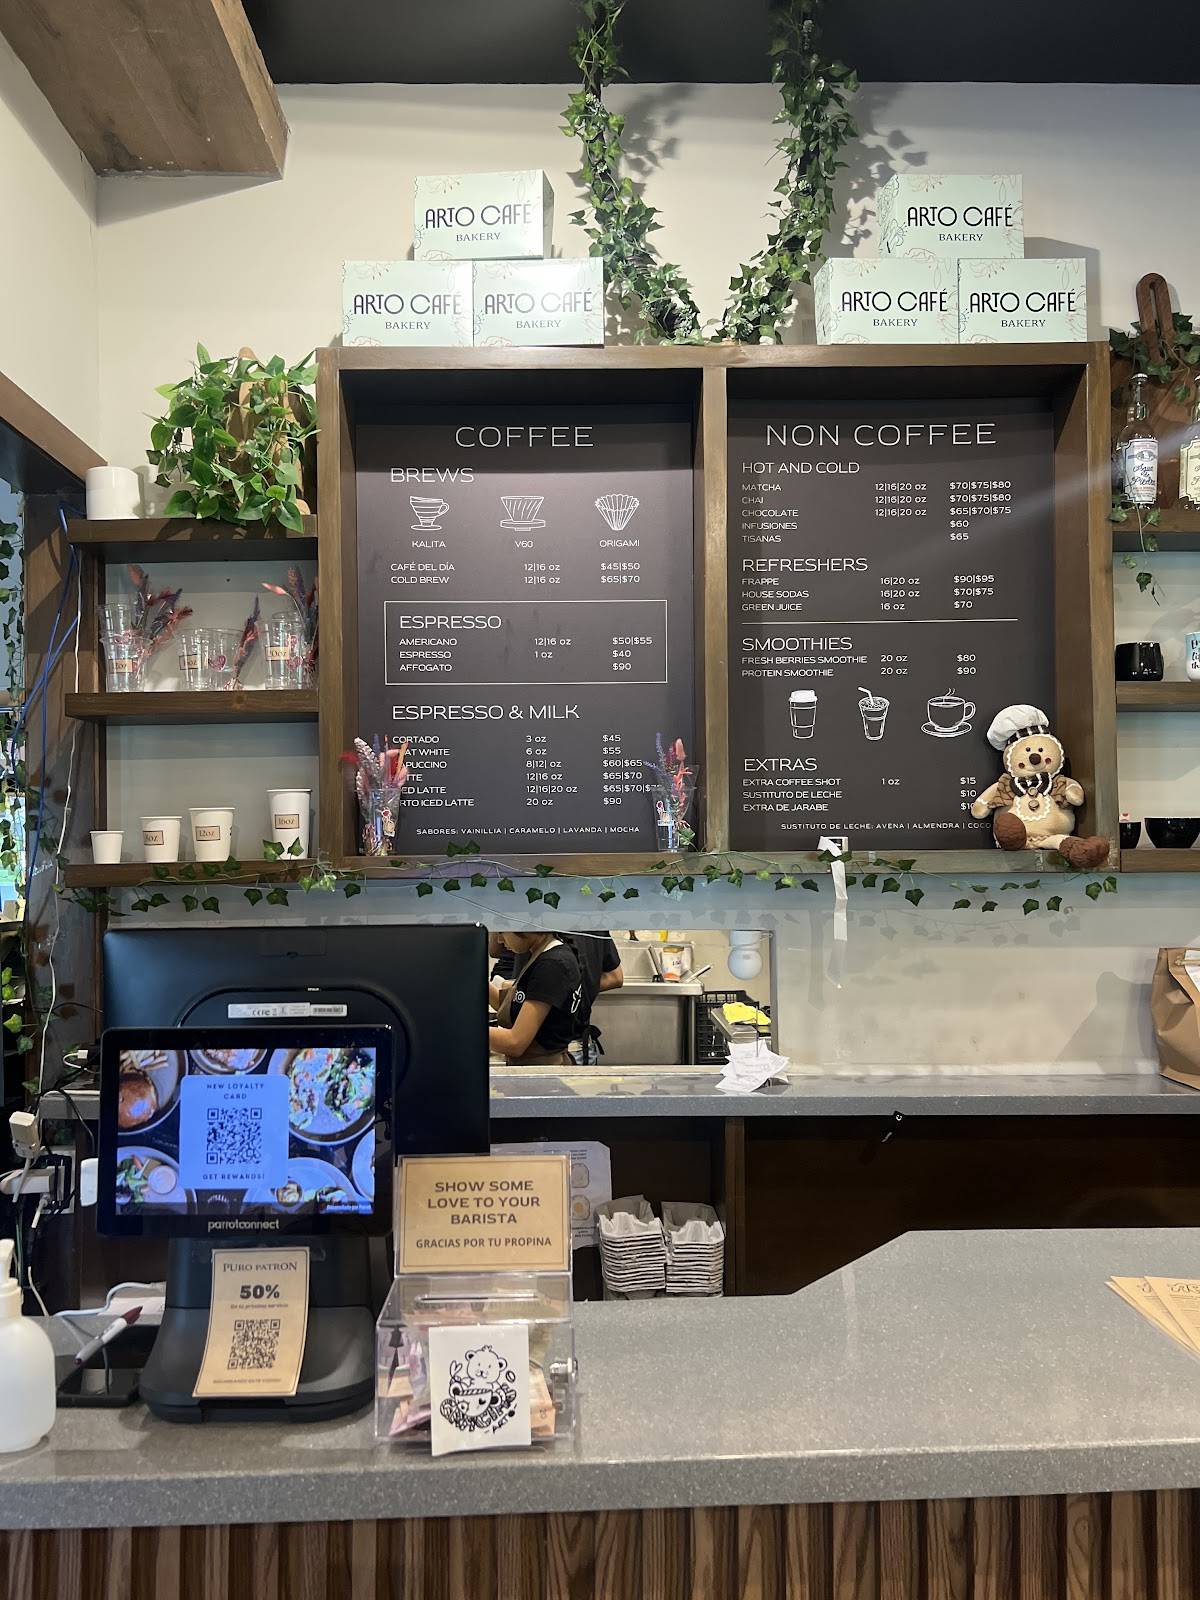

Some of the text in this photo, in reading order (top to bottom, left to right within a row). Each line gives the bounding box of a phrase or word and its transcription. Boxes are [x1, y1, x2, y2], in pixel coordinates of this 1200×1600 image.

[426, 200, 532, 228] ARTO CAFÉ
[908, 204, 1013, 226] ARTO CAFÉ
[457, 233, 500, 241] BAKERY
[354, 292, 462, 315] ARTO CAFÉ
[485, 288, 592, 314] ARTO CAFÉ
[842, 289, 947, 311] ARTO CAFÉ
[970, 289, 1076, 312] ARTO CAFÉ
[517, 320, 561, 328] BAKERY
[456, 427, 593, 447] COFFEE
[767, 424, 996, 446] NON COFFEE
[743, 462, 859, 473] HOT AND COLD
[390, 467, 474, 483] BREWS
[876, 483, 912, 491] 12|16|20
[950, 481, 1011, 490] $70|$75|$80
[875, 496, 911, 504] 12|16|20
[950, 494, 1011, 503] $70|$75|$80
[875, 508, 912, 517] 12|16|20
[950, 507, 1011, 515] $65|$70|$75
[743, 522, 797, 530] INFUSIONES
[412, 540, 446, 548] KALITA
[515, 540, 533, 548] V60
[391, 561, 640, 572] CAFÉ DEL DÍA 12|16 $45|$50
[743, 558, 868, 571] REFRESHERS
[391, 575, 640, 584] COLD BREW 12|16 $65|$70
[881, 577, 905, 585] 16|20
[954, 575, 994, 583] $90|$95
[881, 590, 905, 598] 16|20
[954, 588, 993, 596] $70|$75
[742, 603, 774, 611] GREEN
[776, 603, 802, 611] JUICE
[400, 616, 501, 628] ESPRESSO
[400, 637, 652, 646] AMERICANO 12|16 $50|$55
[743, 637, 852, 650] SMOOTHIES
[881, 654, 893, 662] 20
[881, 667, 893, 675] 20
[393, 705, 579, 719] ESPRESSO & MILK
[393, 736, 439, 744] CORTADO
[419, 748, 450, 756] WHITE
[603, 759, 642, 768] $60|$65
[745, 758, 817, 771] EXTRAS
[527, 773, 548, 781] 12|16
[603, 772, 642, 780] $65|$70
[815, 778, 841, 786] SHOT
[417, 785, 563, 794] LATTE 12|16|20
[400, 799, 419, 807] RTO
[421, 799, 443, 807] ICED
[604, 797, 621, 805] $90
[563, 826, 602, 834] LAVANDA
[876, 822, 904, 830] AVENA
[228, 1082, 264, 1090] LOYALTY
[224, 1092, 246, 1100] CARD
[435, 1181, 533, 1192] SHOW SOME
[428, 1197, 540, 1208] LOVE TO YOUR
[451, 1214, 517, 1224] BARISTA
[208, 1219, 279, 1232] parrotconnect
[416, 1237, 551, 1248] GRACIAS POR TU PROPINA
[224, 1262, 297, 1272] PURO PATRON
[240, 1285, 279, 1299] 50%
